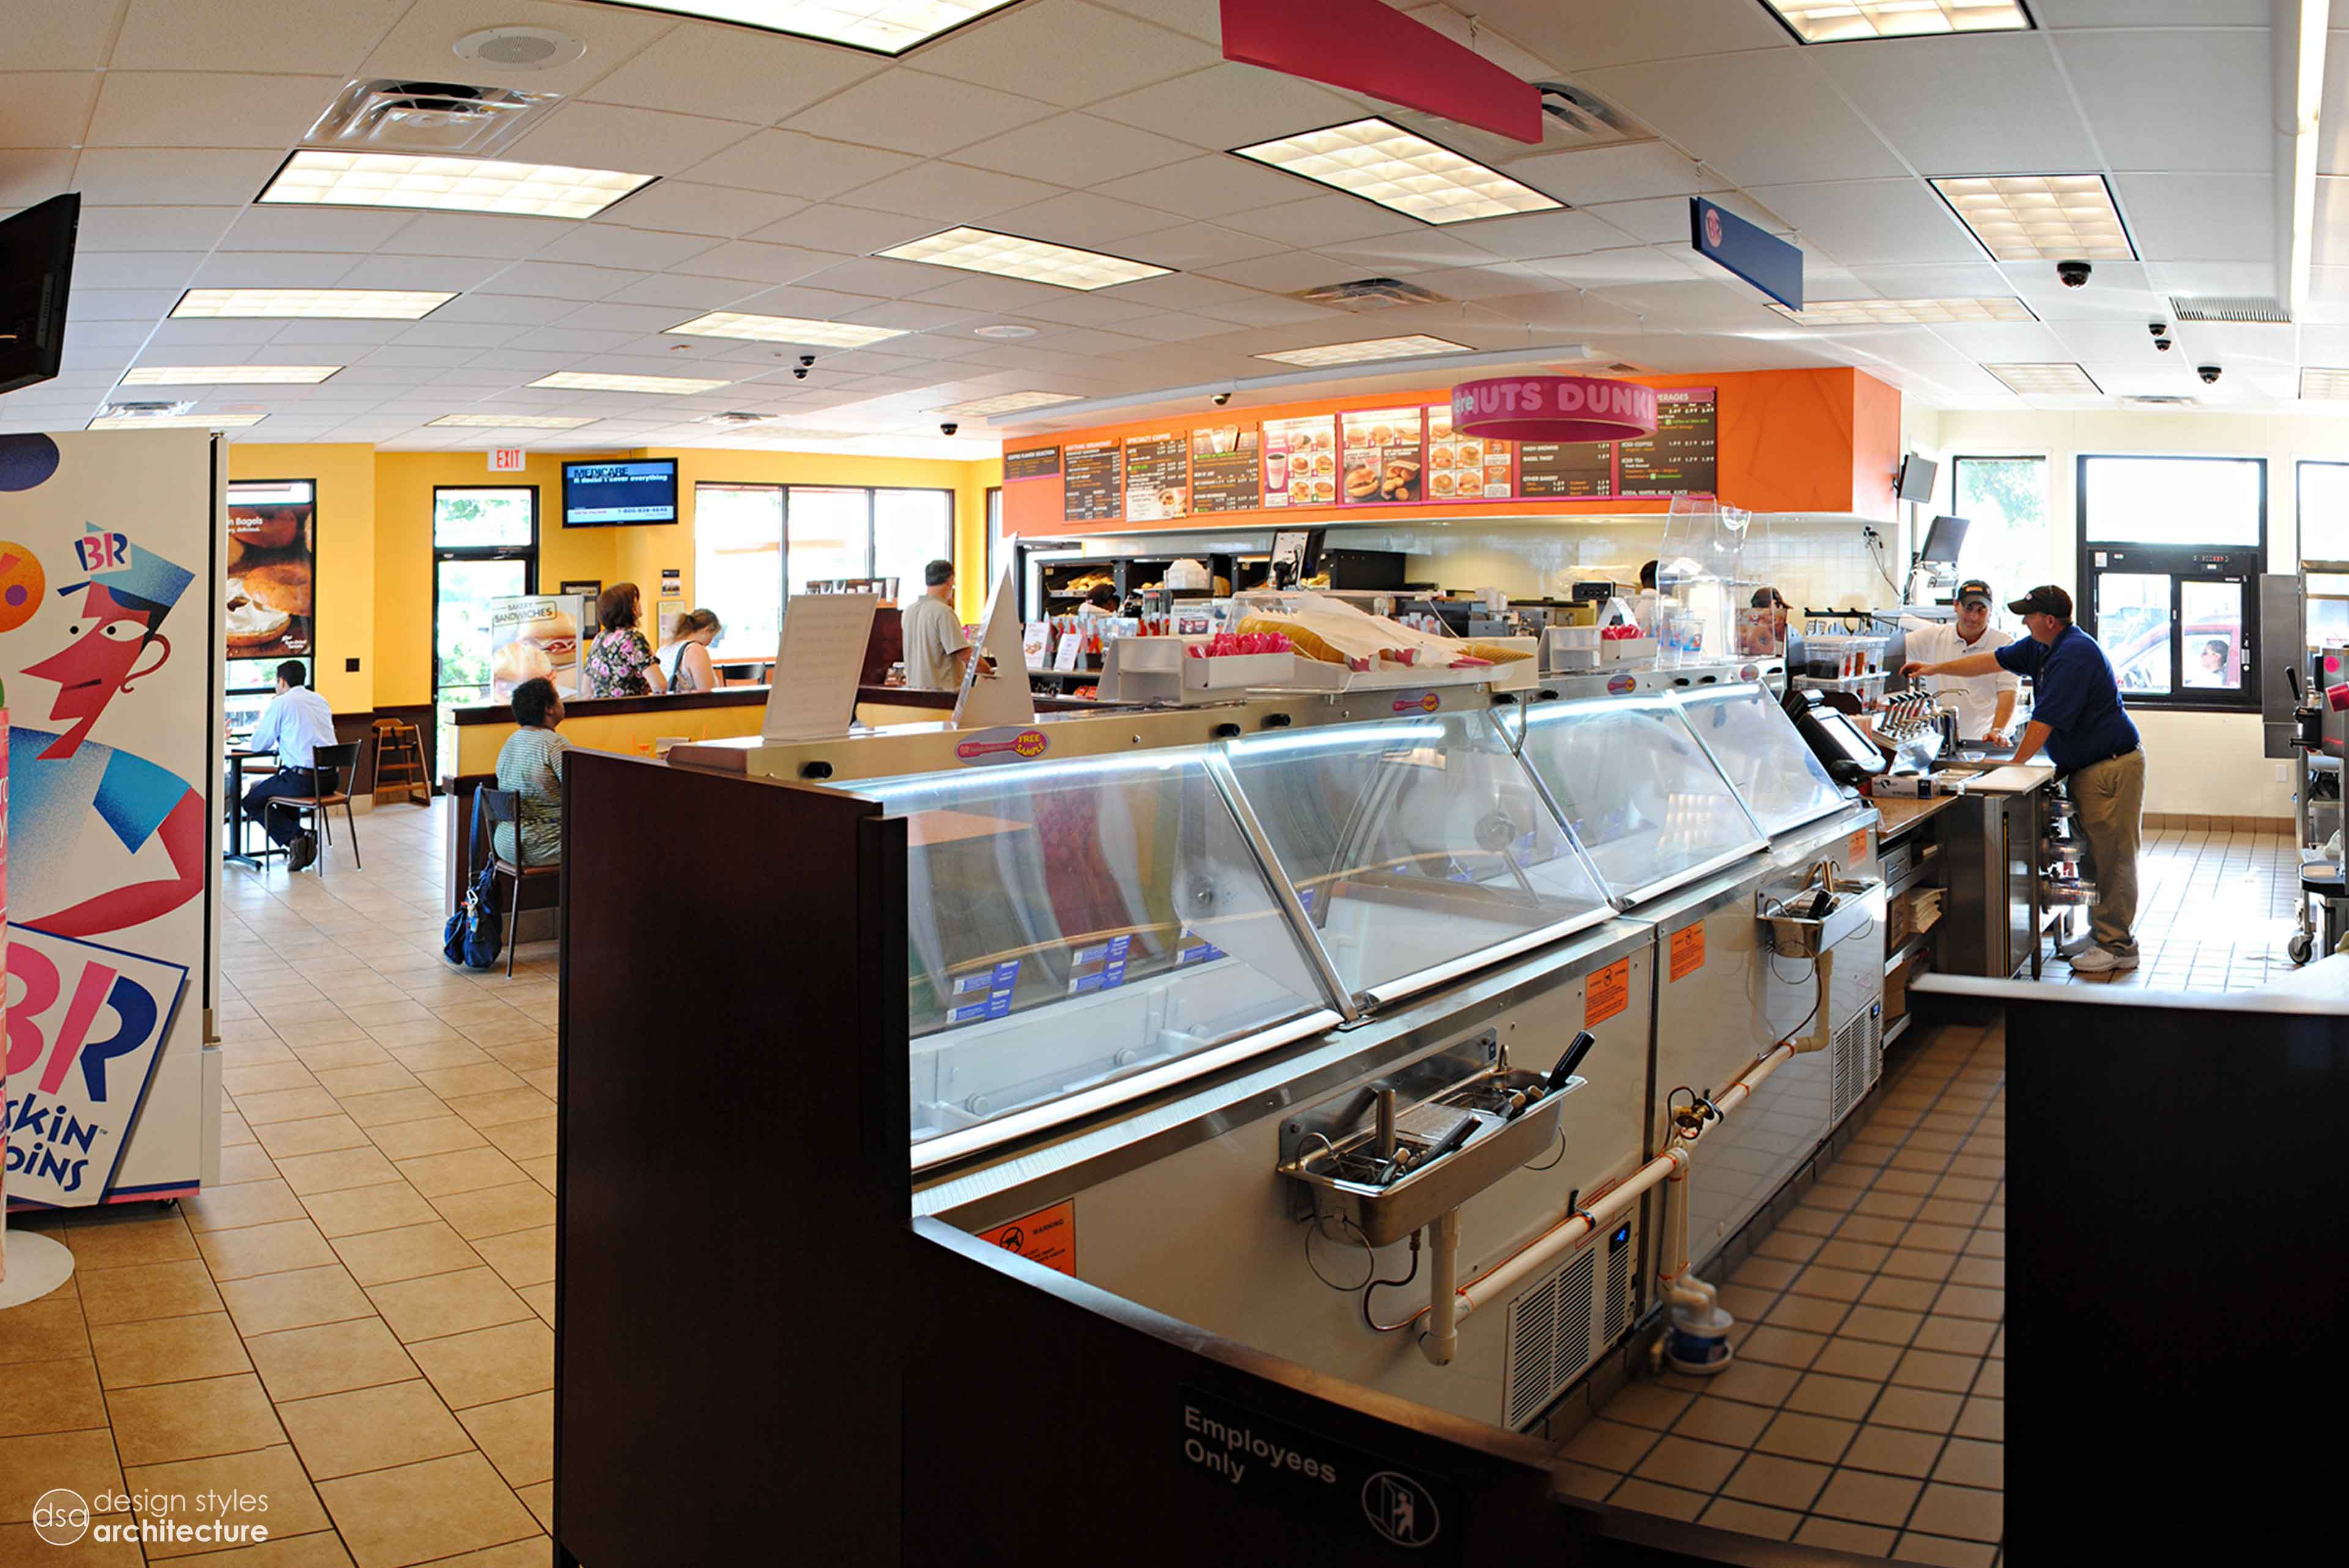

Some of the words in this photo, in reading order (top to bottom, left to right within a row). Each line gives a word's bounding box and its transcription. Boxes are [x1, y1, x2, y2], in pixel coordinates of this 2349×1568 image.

[496, 450, 521, 469] EXIT
[236, 516, 263, 526] Bagels
[74, 532, 128, 571] BR
[494, 607, 553, 623] SANDWICHES
[1018, 734, 1040, 743] FREE
[1016, 742, 1045, 756] SAMPLE
[1184, 1406, 1337, 1484] Employees
[1184, 1438, 1245, 1484] Only
